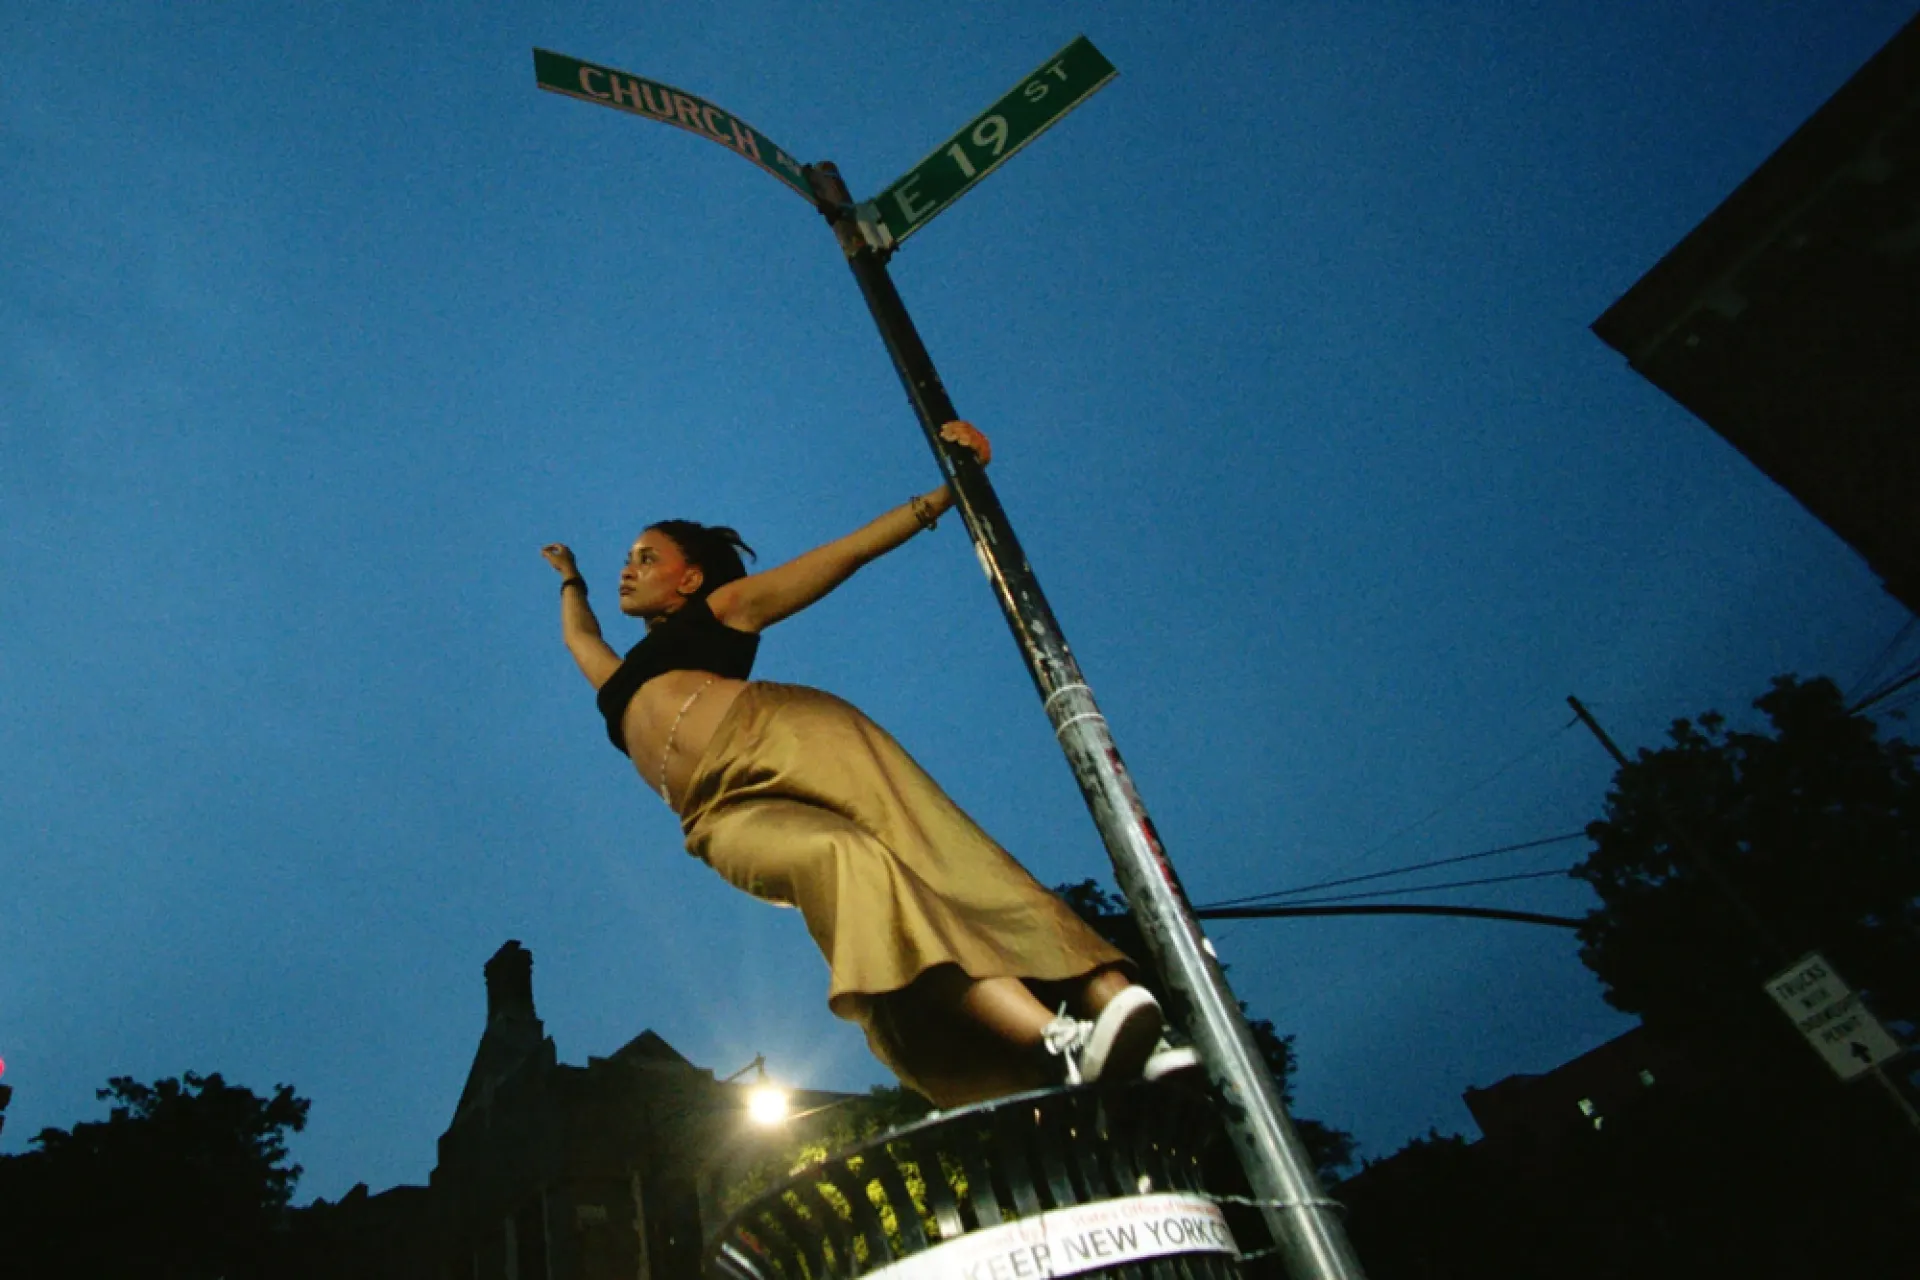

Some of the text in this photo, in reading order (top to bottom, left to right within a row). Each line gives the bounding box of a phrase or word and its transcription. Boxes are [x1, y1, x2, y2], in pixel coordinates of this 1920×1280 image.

[579, 66, 760, 160] CHURCH
[894, 59, 1068, 223] E 19 ST
[961, 1242, 1055, 1280] KEEP
[1061, 1222, 1139, 1263] NEW
[1144, 1216, 1212, 1248] YORK
